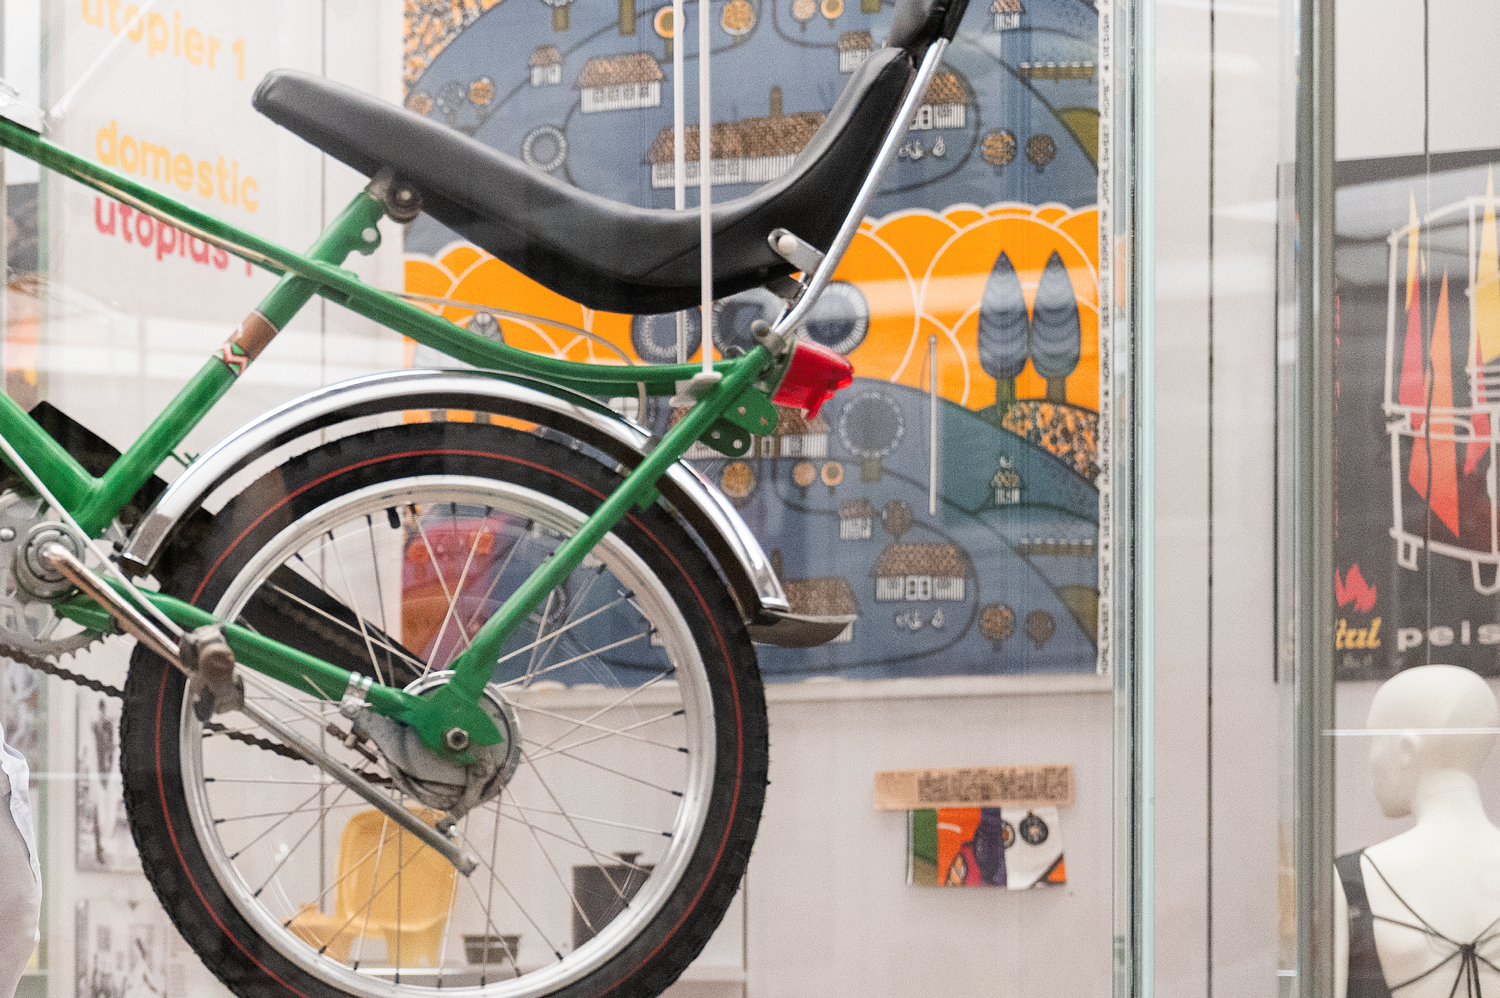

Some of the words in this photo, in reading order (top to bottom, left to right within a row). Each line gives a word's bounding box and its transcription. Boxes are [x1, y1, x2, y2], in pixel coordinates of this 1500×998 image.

[81, 0, 220, 69] utopier
[232, 38, 245, 81] 1
[95, 119, 259, 212] domestic
[1335, 617, 1382, 650] tul
